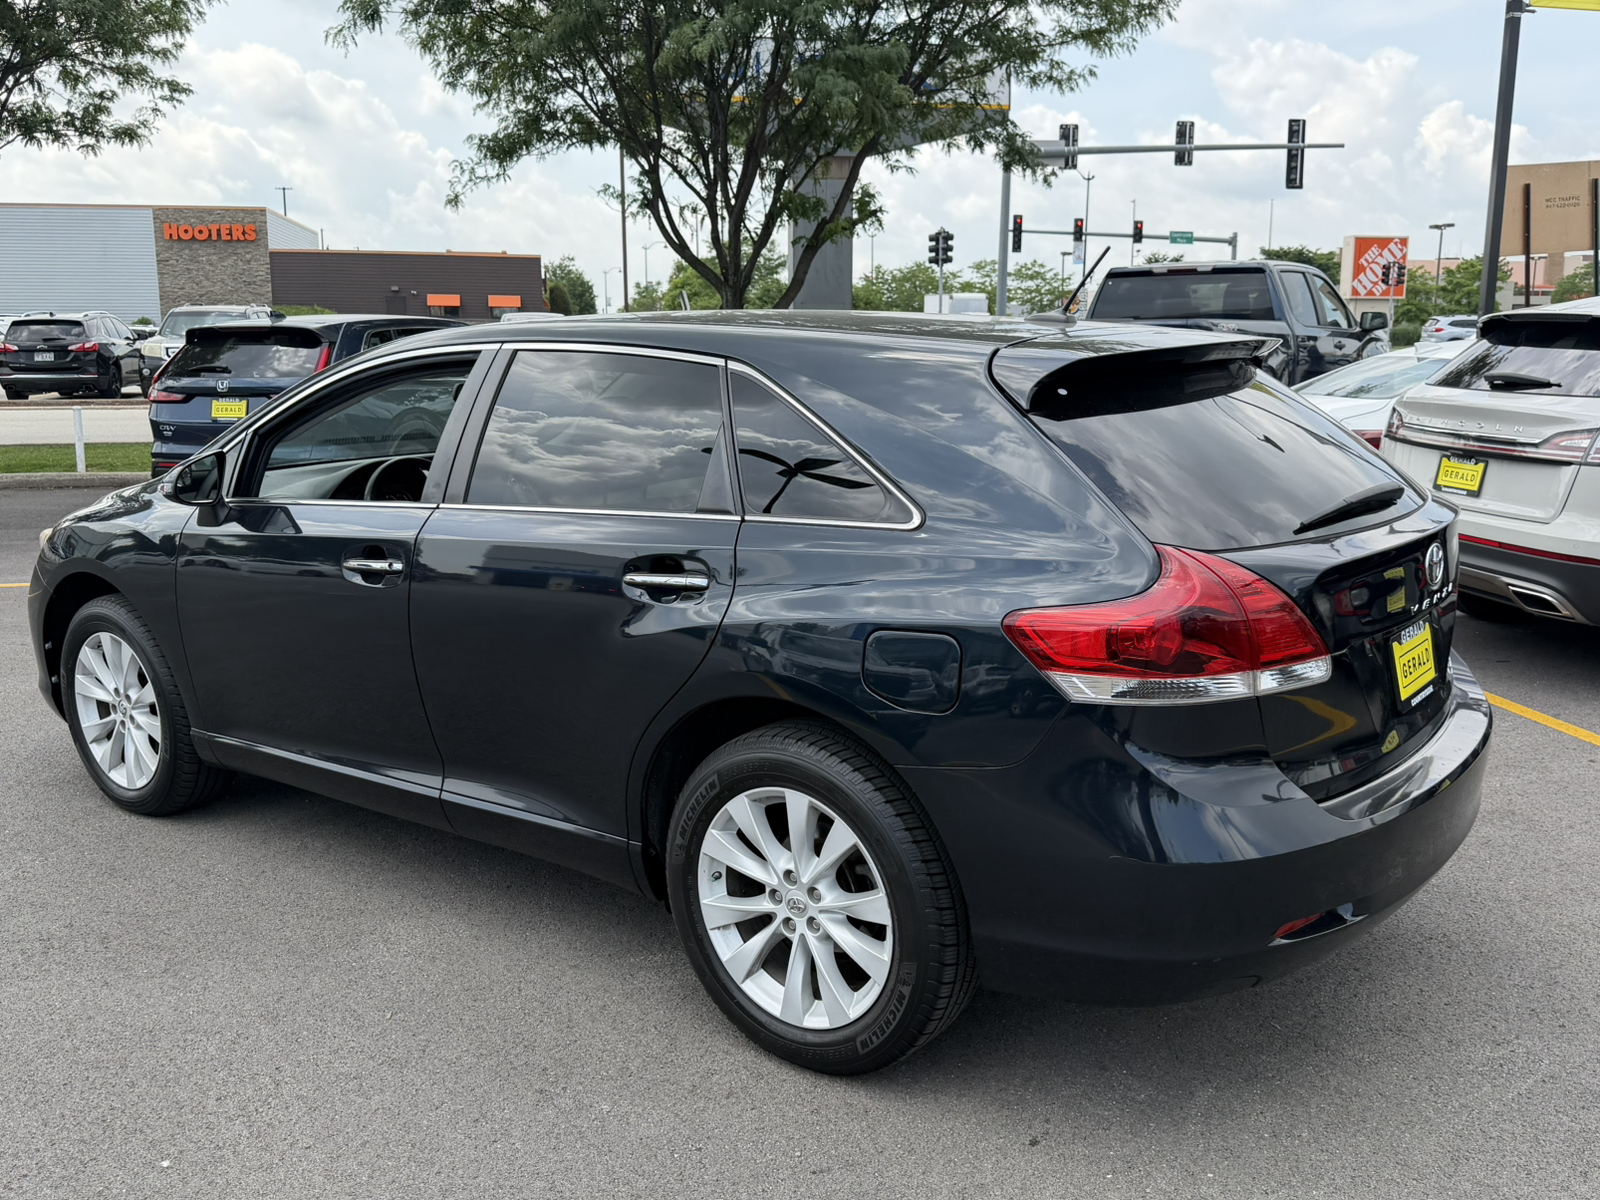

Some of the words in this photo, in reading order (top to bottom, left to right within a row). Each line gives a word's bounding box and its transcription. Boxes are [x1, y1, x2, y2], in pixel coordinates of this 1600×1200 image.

[163, 223, 257, 242] HOOTERS
[1351, 238, 1407, 296] HOME
[1358, 243, 1382, 268] THE
[1444, 469, 1476, 482] GERALD
[1400, 620, 1425, 643] GERALD
[1401, 648, 1431, 679] GERALD
[678, 778, 718, 841] MICHELIN
[860, 989, 907, 1051] MICHELIN
